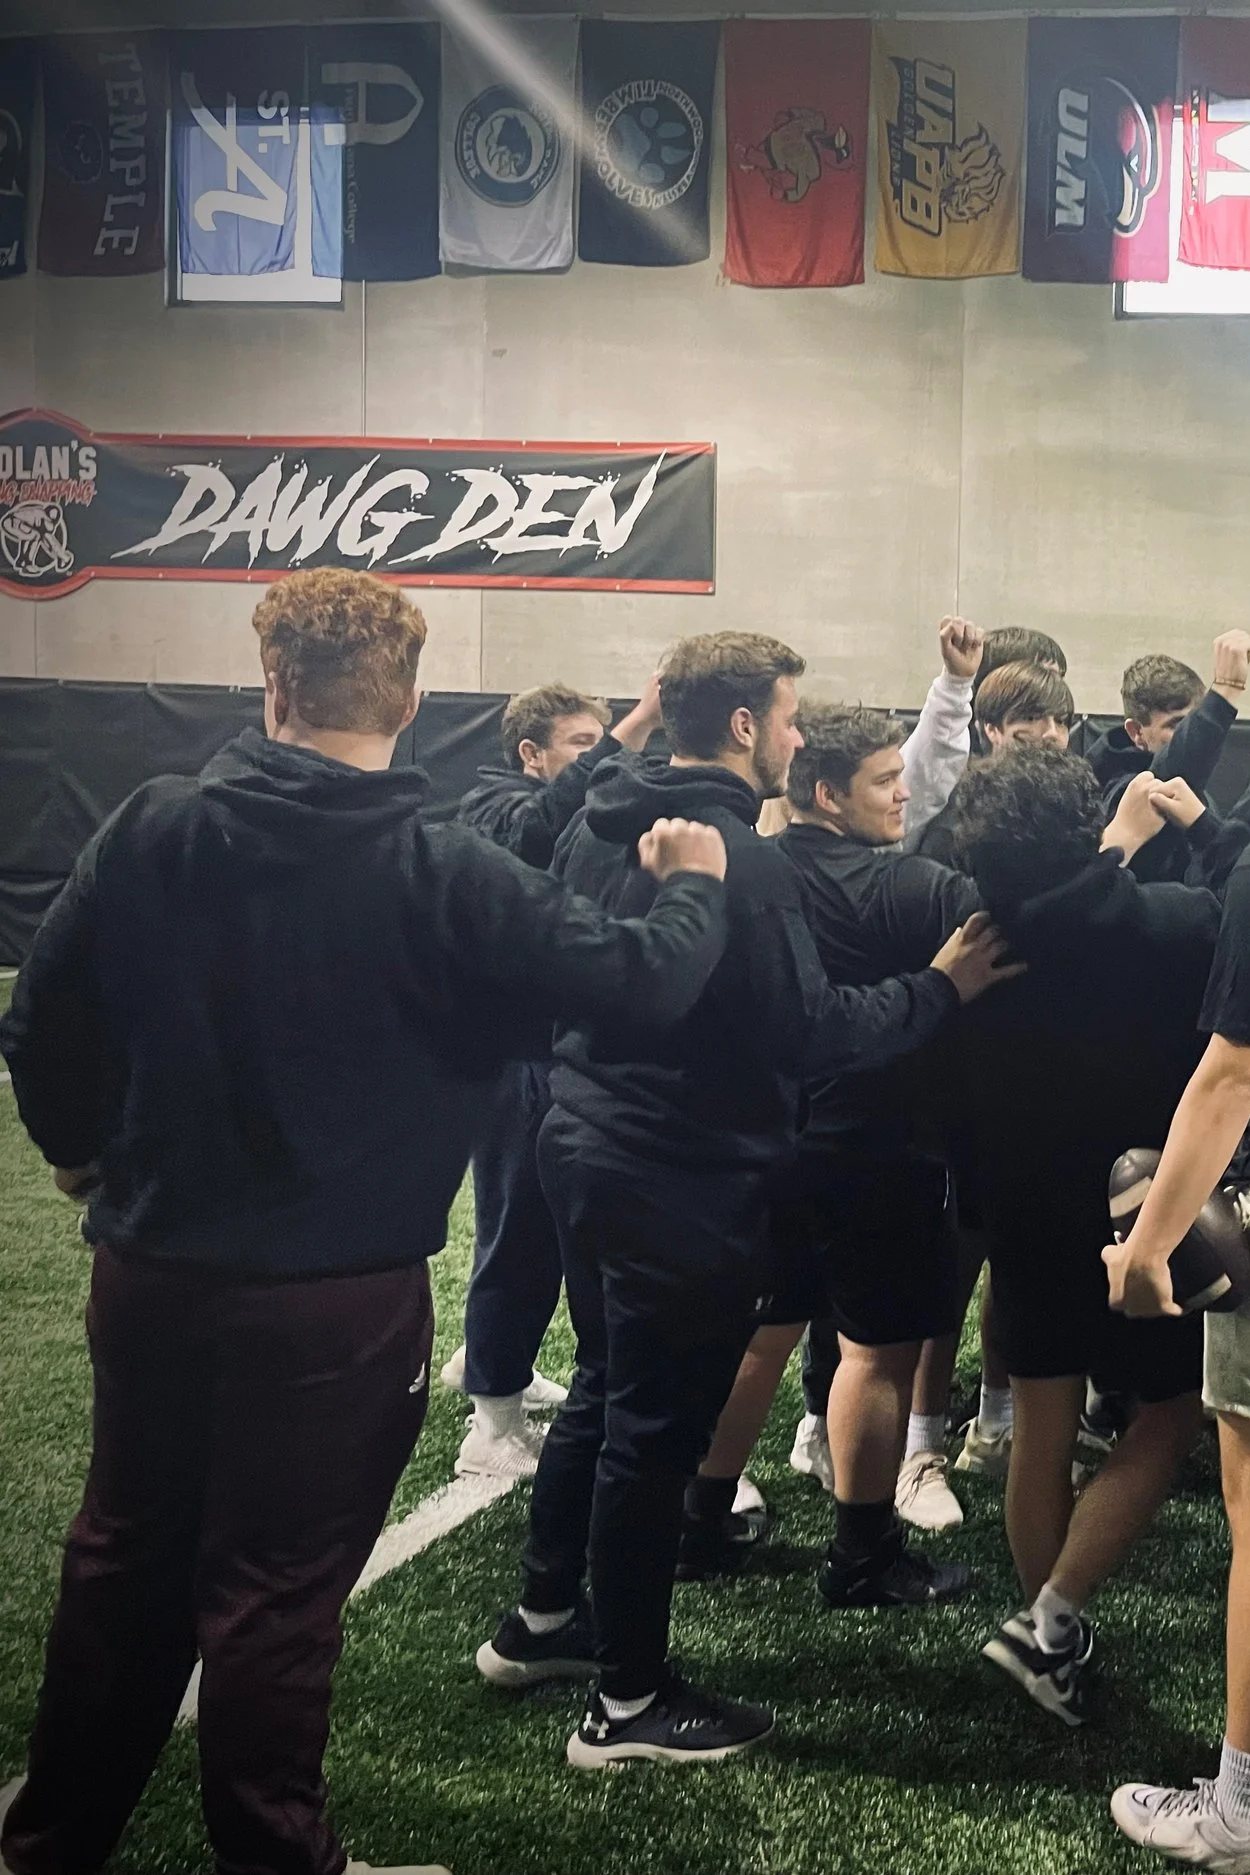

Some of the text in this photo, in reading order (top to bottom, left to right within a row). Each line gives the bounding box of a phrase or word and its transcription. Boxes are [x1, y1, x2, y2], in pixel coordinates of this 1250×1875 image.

[93, 42, 146, 257] TEMPLE
[257, 89, 291, 154] ST.
[321, 62, 424, 146] A
[900, 59, 955, 235] UAPB
[1055, 87, 1090, 228] ULM
[109, 447, 669, 570] DAWG DEN
